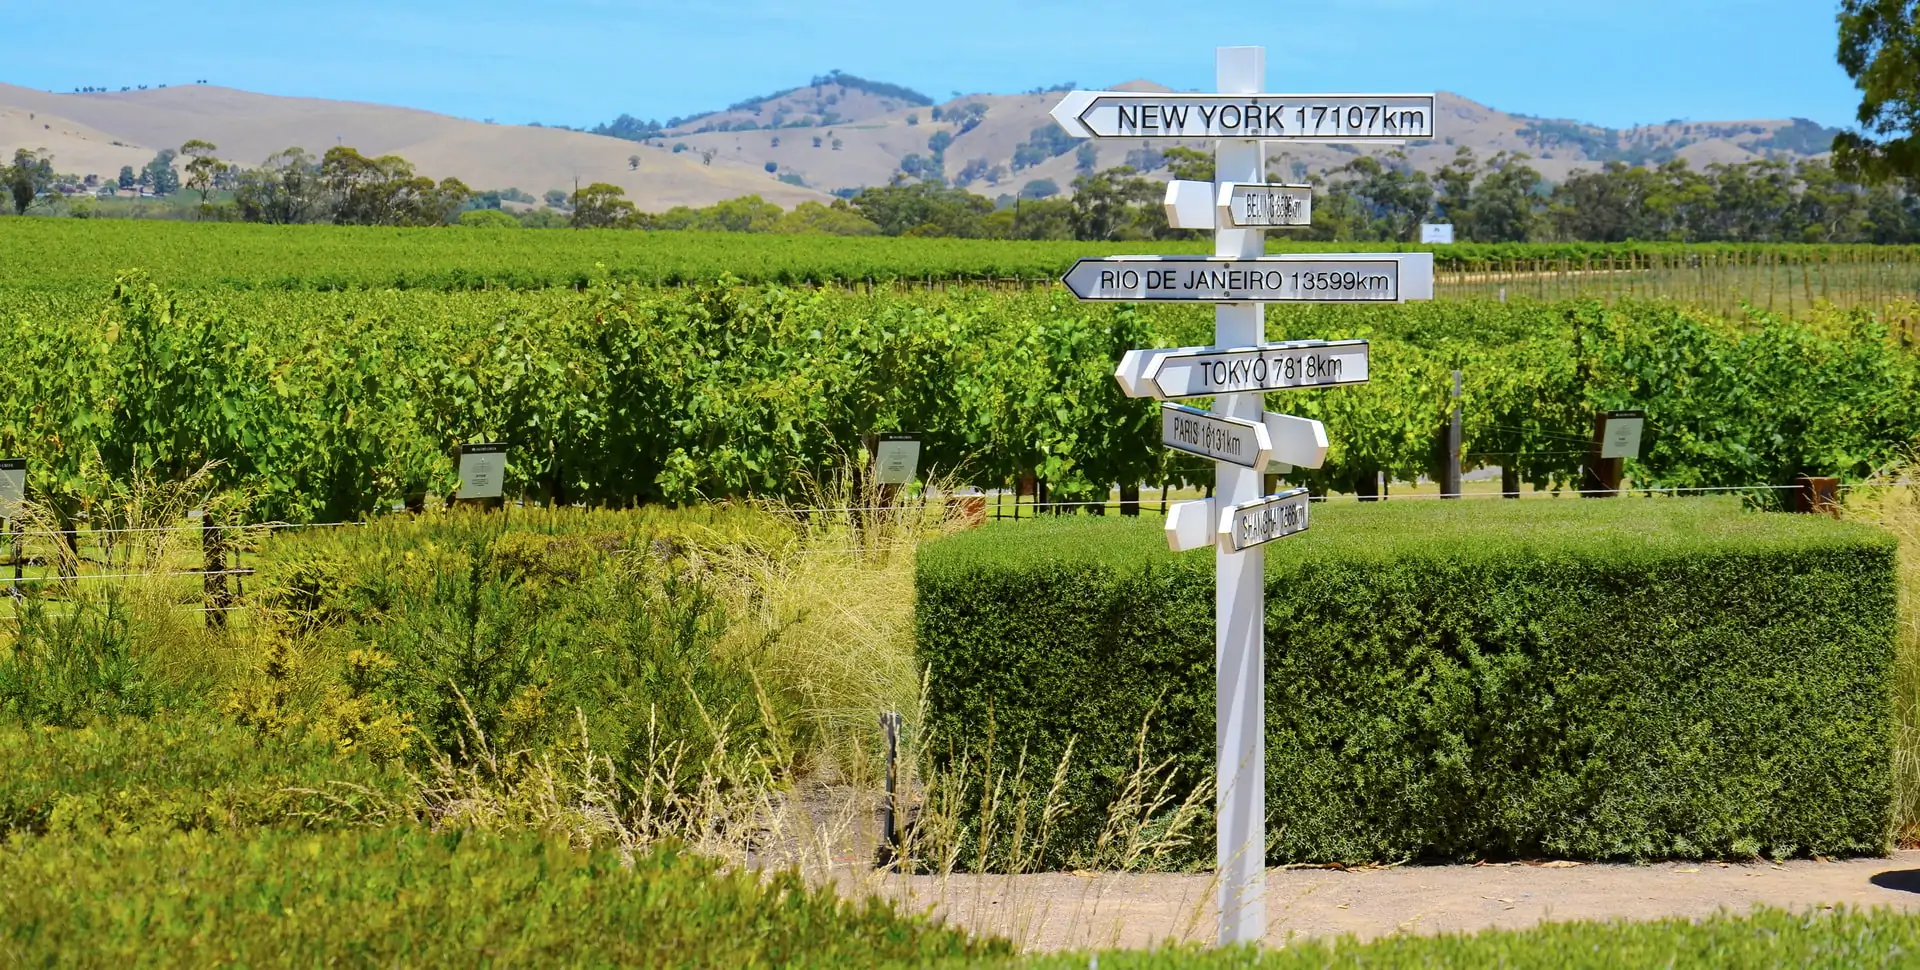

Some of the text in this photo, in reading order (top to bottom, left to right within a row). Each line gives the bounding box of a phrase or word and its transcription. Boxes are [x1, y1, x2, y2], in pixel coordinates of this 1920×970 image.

[1118, 104, 1424, 130] NEW YORK 17107km
[1246, 193, 1275, 218] BEIJING
[1101, 270, 1389, 291] RIO DE JANEIRO 13599km
[1200, 353, 1343, 386] TOKYO 7818km
[1173, 416, 1241, 456] PARIS 16131km
[1242, 507, 1279, 540] SHANGHAI
